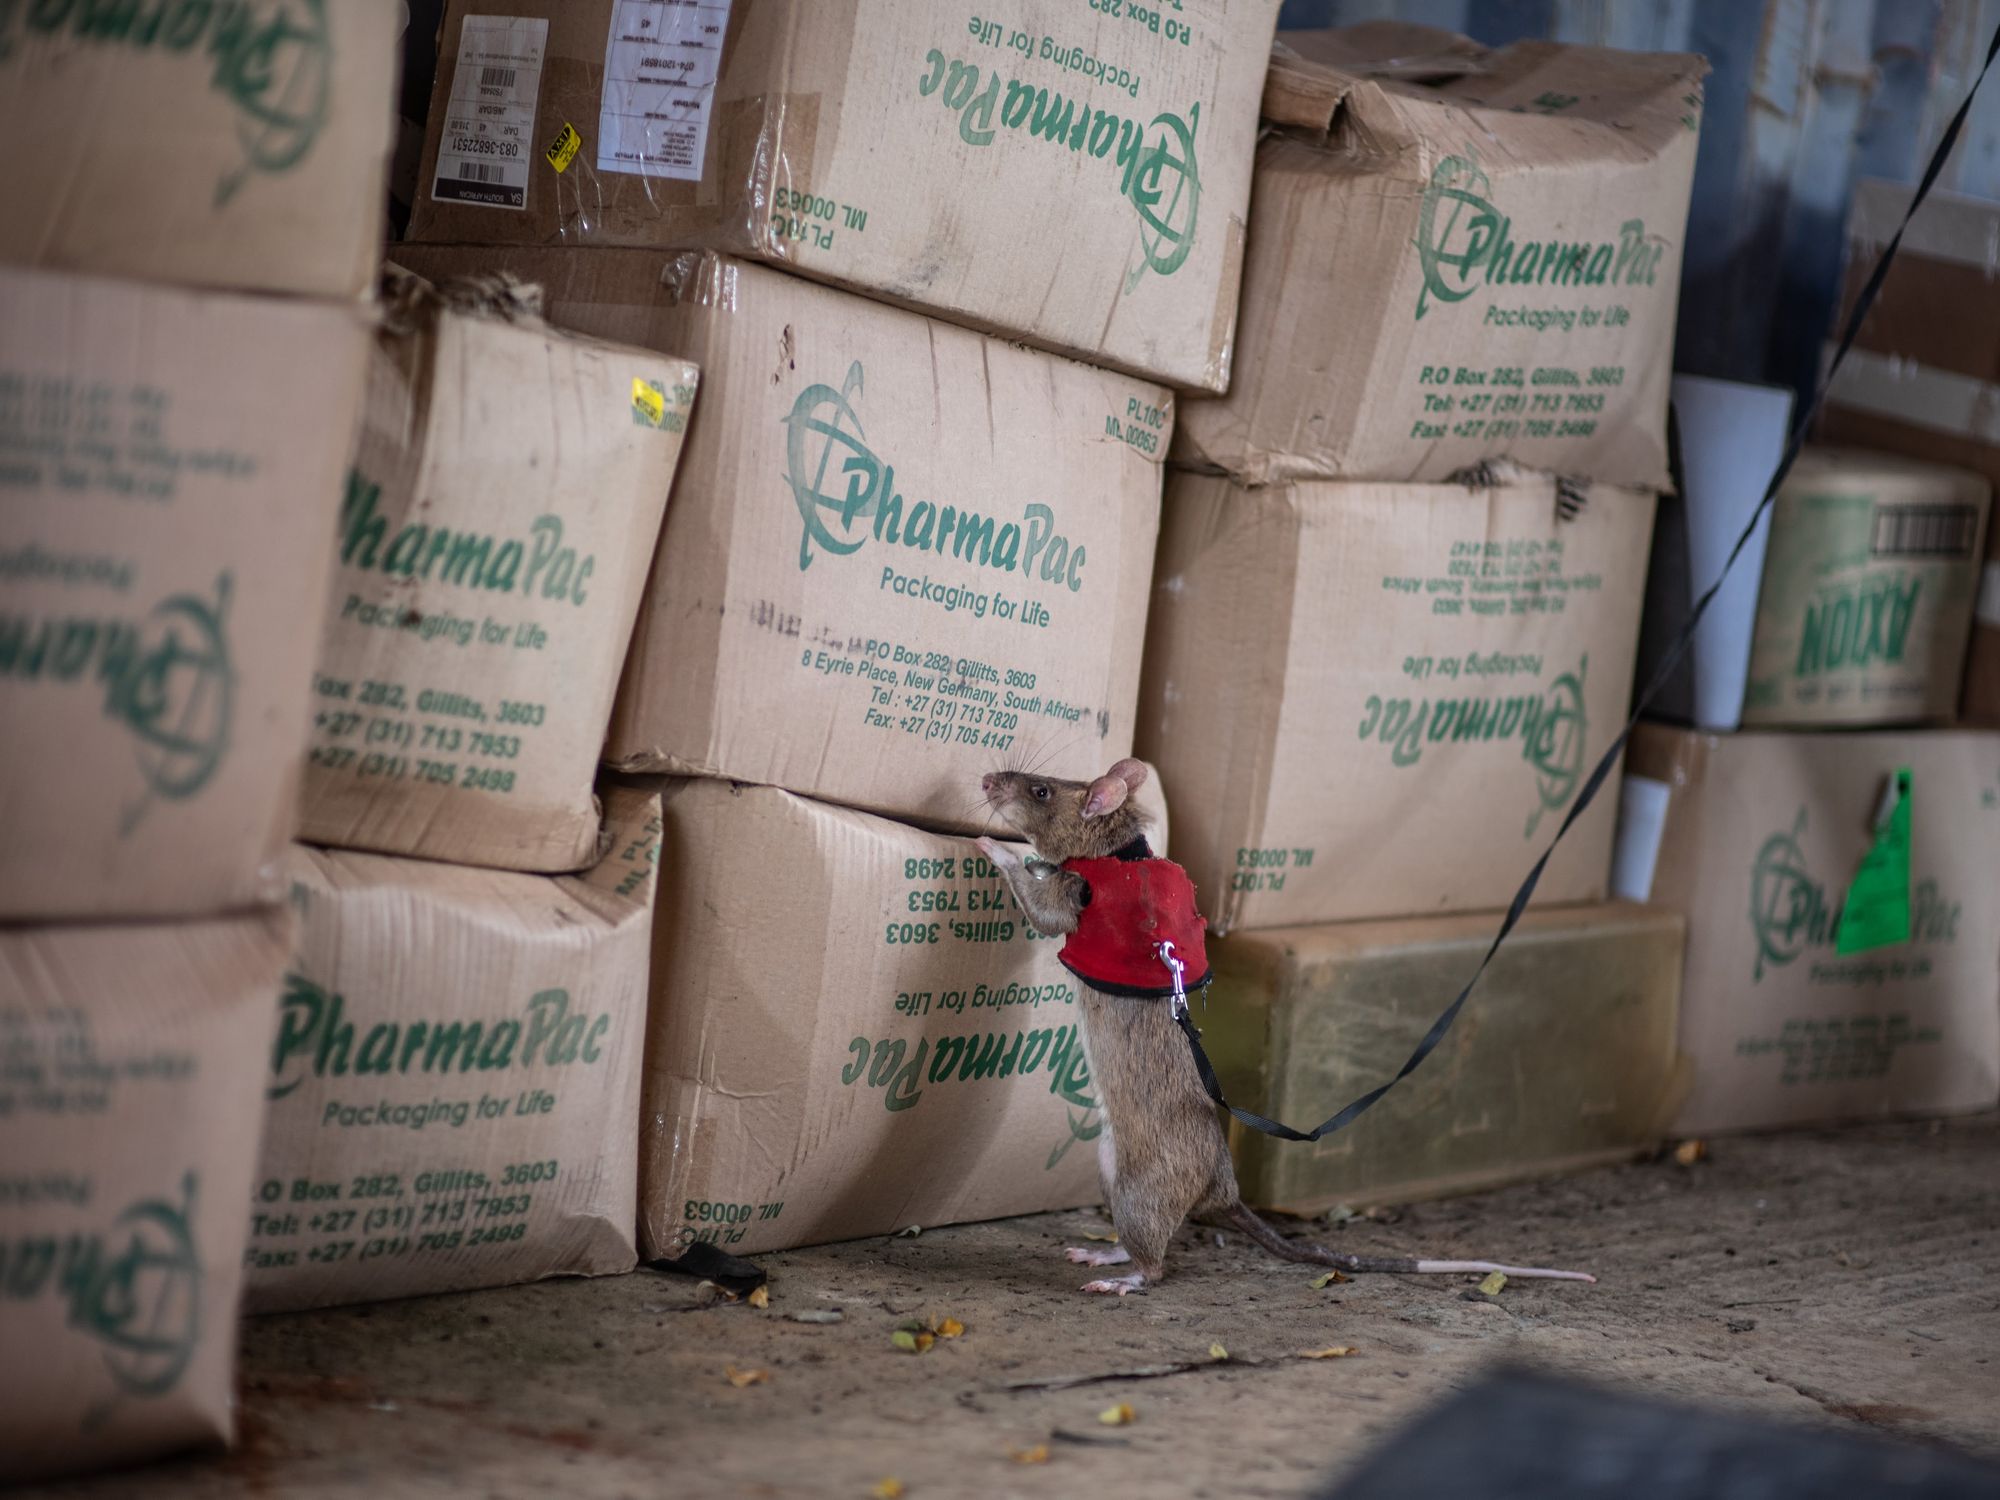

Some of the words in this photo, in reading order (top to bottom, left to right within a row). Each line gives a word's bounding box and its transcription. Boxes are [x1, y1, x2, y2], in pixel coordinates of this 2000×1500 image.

[968, 16, 1004, 49] Life
[1127, 3, 1161, 33] Box
[1006, 31, 1035, 60] for
[1039, 37, 1141, 98] Packaging
[919, 48, 1171, 205] PharmaPac
[451, 136, 519, 157] 083-36822531
[510, 191, 523, 204] SA
[775, 187, 836, 222] 00063
[841, 204, 868, 233] ML
[1458, 213, 1664, 289] PharmaPac
[1483, 304, 1577, 332] Packaging
[1579, 304, 1601, 327] for
[1603, 305, 1631, 328] Life
[1453, 367, 1487, 386] Box
[1459, 393, 1493, 412] +27
[1452, 420, 1485, 439] +27
[840, 456, 1087, 593] PharmaPac
[880, 566, 989, 618] Packaging
[991, 592, 1018, 621] for
[1020, 599, 1051, 628] Life
[479, 615, 509, 646] for
[513, 620, 549, 651] Life
[1793, 578, 1921, 680] AXION
[893, 645, 922, 667] Box
[1004, 669, 1037, 690] 3603
[1401, 656, 1435, 681] Life
[1436, 655, 1461, 681] for
[1464, 650, 1543, 678] Packaging
[800, 649, 813, 668] 8
[814, 651, 855, 676] Eyrie
[856, 660, 900, 688] Place,
[903, 670, 935, 691] New
[937, 676, 1000, 708] Germany,
[1002, 690, 1042, 714] South
[1043, 699, 1081, 722] Africa
[494, 699, 546, 727] 3603
[904, 694, 930, 713] +27
[930, 698, 957, 723] (31)
[959, 705, 984, 726] 713
[986, 709, 1019, 731] 7820
[365, 716, 414, 748] (31)
[419, 723, 462, 752] 713
[468, 730, 522, 759] 7953
[863, 707, 896, 729] Fax:
[899, 715, 926, 735] +27
[925, 720, 952, 744] (31)
[955, 725, 979, 746] 705
[981, 731, 1015, 752] 4147
[1357, 694, 1563, 768] PharmaPac
[413, 757, 456, 785] 705
[461, 765, 517, 793] 2498
[903, 858, 956, 879] 2498
[1235, 847, 1288, 869] 00063
[1231, 872, 1286, 893] PL10C
[907, 891, 961, 912] 7953
[967, 889, 1005, 911] 713
[885, 923, 941, 945] 3603
[948, 918, 1015, 943] Gillits,
[894, 991, 932, 1017] Life
[936, 990, 968, 1015] for
[270, 987, 611, 1079] PharmaPac
[321, 1099, 470, 1131] Packaging
[475, 1092, 511, 1121] for
[514, 1088, 556, 1117] Life
[290, 1175, 341, 1203] Box
[413, 1168, 492, 1196] Gillits,
[500, 1159, 559, 1184] 3603
[306, 1209, 358, 1234] +27
[363, 1205, 413, 1236] (31)
[420, 1198, 466, 1225] 713
[473, 1194, 532, 1219] 7953
[683, 1200, 753, 1224] 00063
[757, 1201, 785, 1221] ML
[305, 1238, 357, 1264] +27
[359, 1232, 410, 1263] (31)
[418, 1229, 464, 1254] 705
[467, 1222, 528, 1247] 2498
